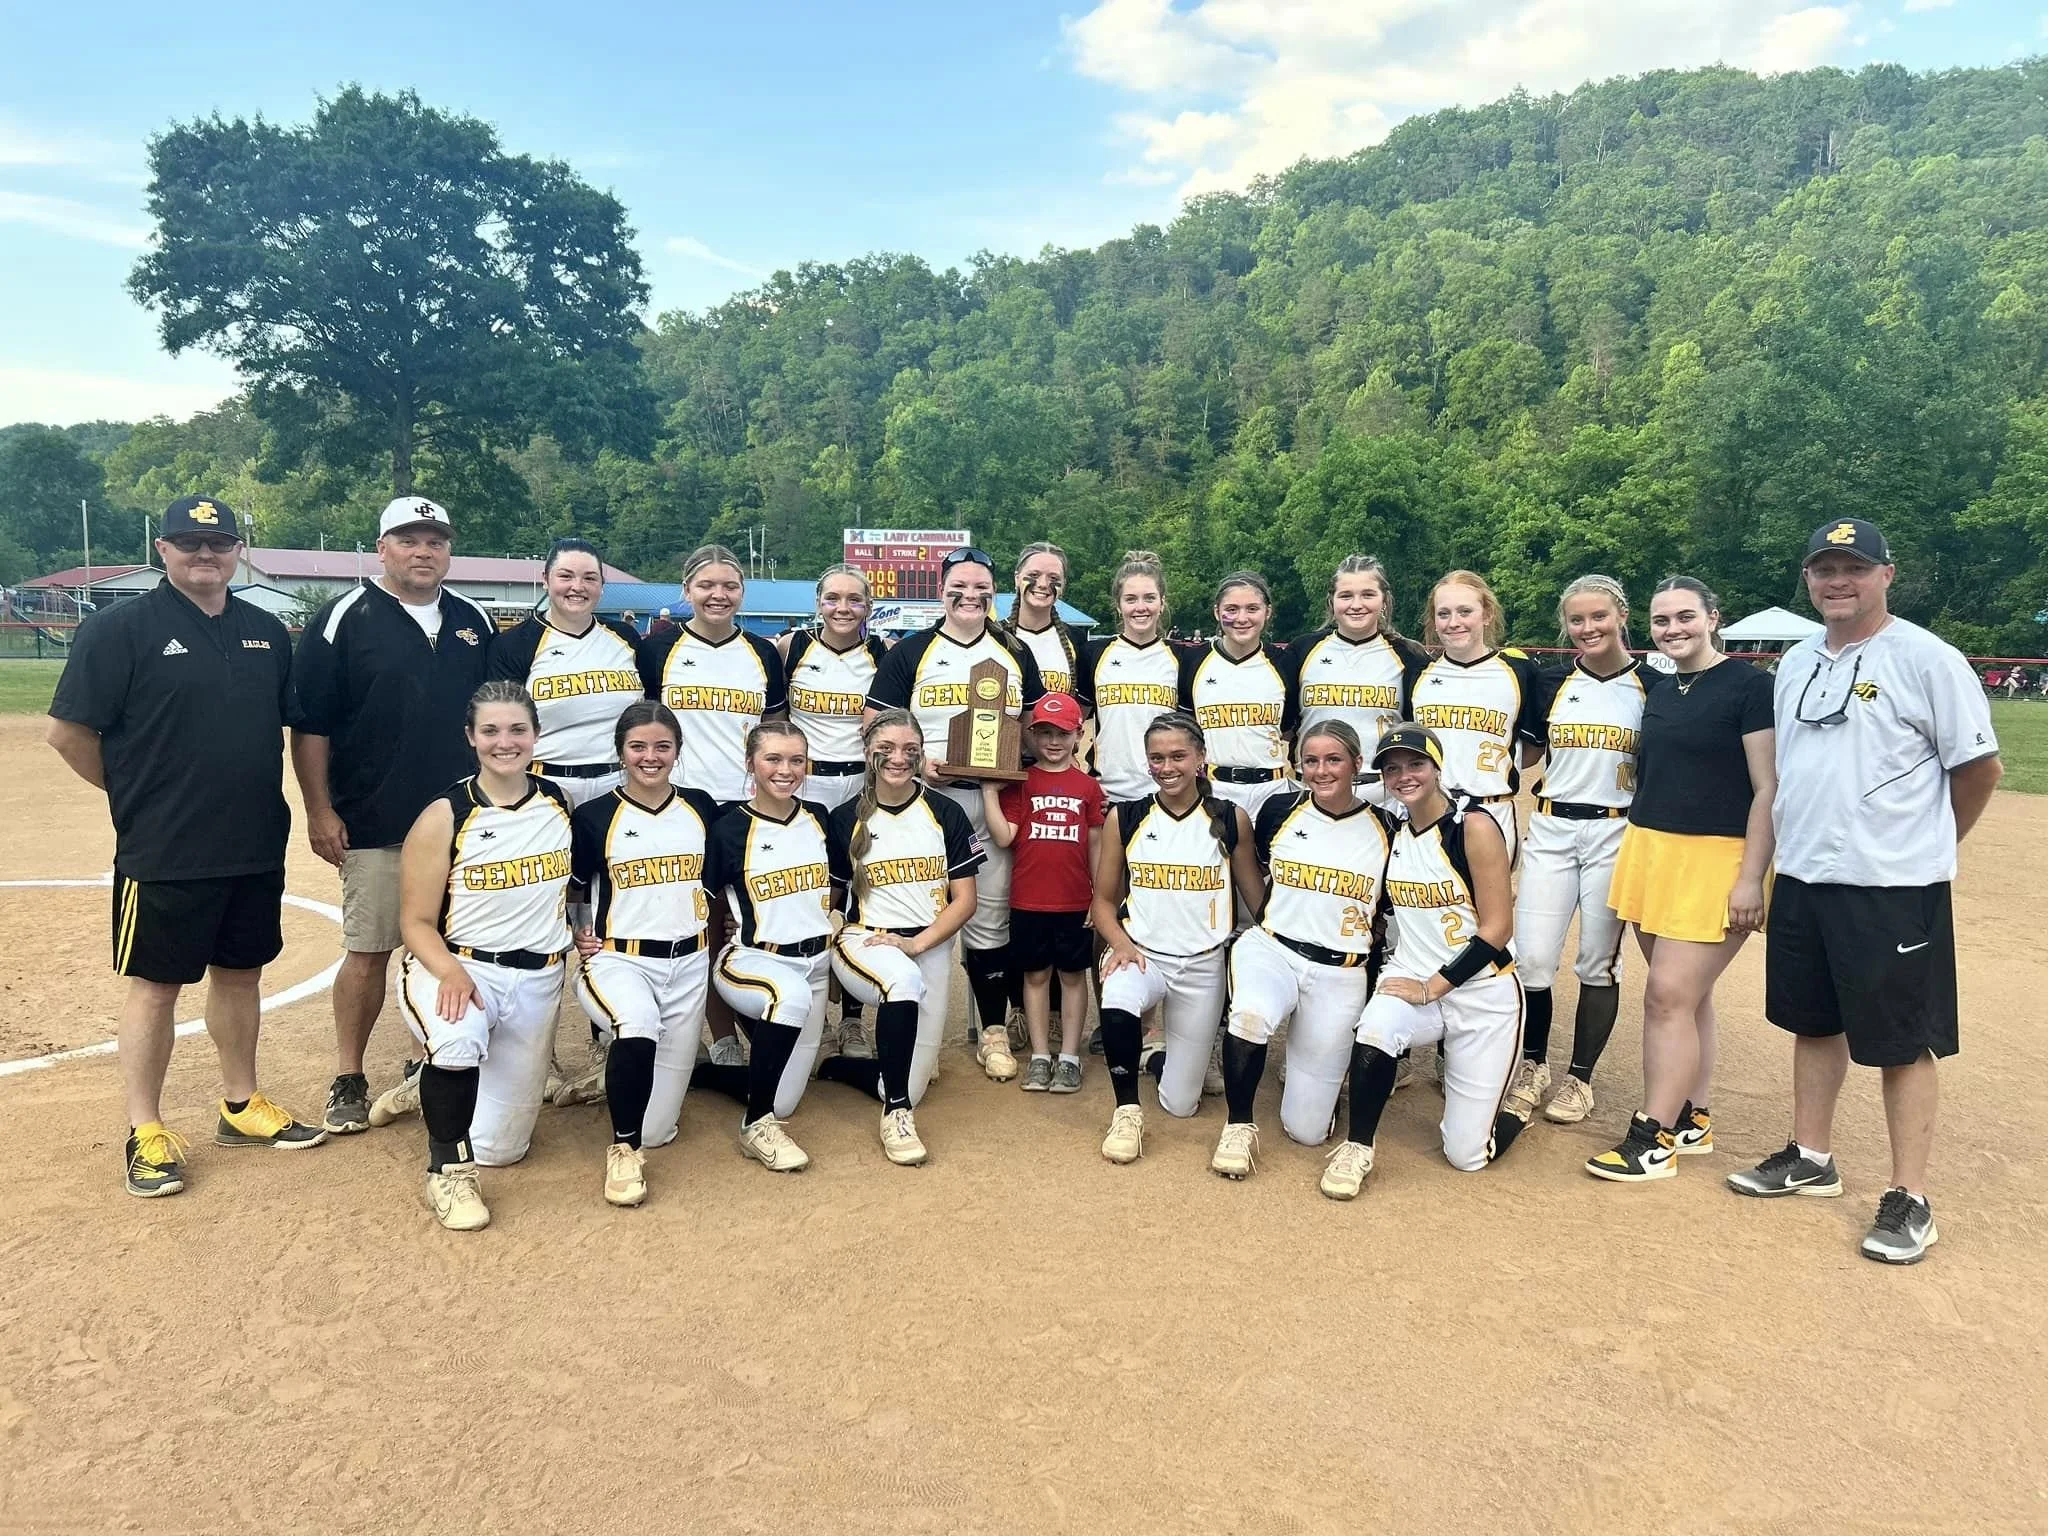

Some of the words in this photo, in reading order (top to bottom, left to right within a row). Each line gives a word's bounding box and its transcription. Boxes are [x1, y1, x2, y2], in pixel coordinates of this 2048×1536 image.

[884, 533, 908, 542] LADY
[911, 532, 965, 543] CARDINALS
[855, 549, 873, 557] BALL
[892, 549, 917, 557] STRIKE
[918, 546, 926, 560] 2
[870, 605, 901, 620] Zone
[242, 640, 270, 649] EAGLES
[533, 670, 643, 701] CENTRAL
[1097, 684, 1178, 709] CENTRAL
[1303, 684, 1399, 710] CENTRAL
[667, 686, 765, 715] CENTRAL
[1043, 700, 1063, 712] C
[1197, 703, 1280, 729] CENTRAL
[1475, 740, 1509, 772] 27
[1031, 796, 1083, 815] ROCK
[1046, 812, 1067, 822] THE
[1028, 823, 1080, 843] FIELD
[1129, 862, 1225, 891] CENTRAL
[1272, 858, 1375, 905] CENTRAL
[1386, 879, 1465, 908] NTRAL
[1208, 898, 1216, 930] 1
[1440, 912, 1467, 947] 2
